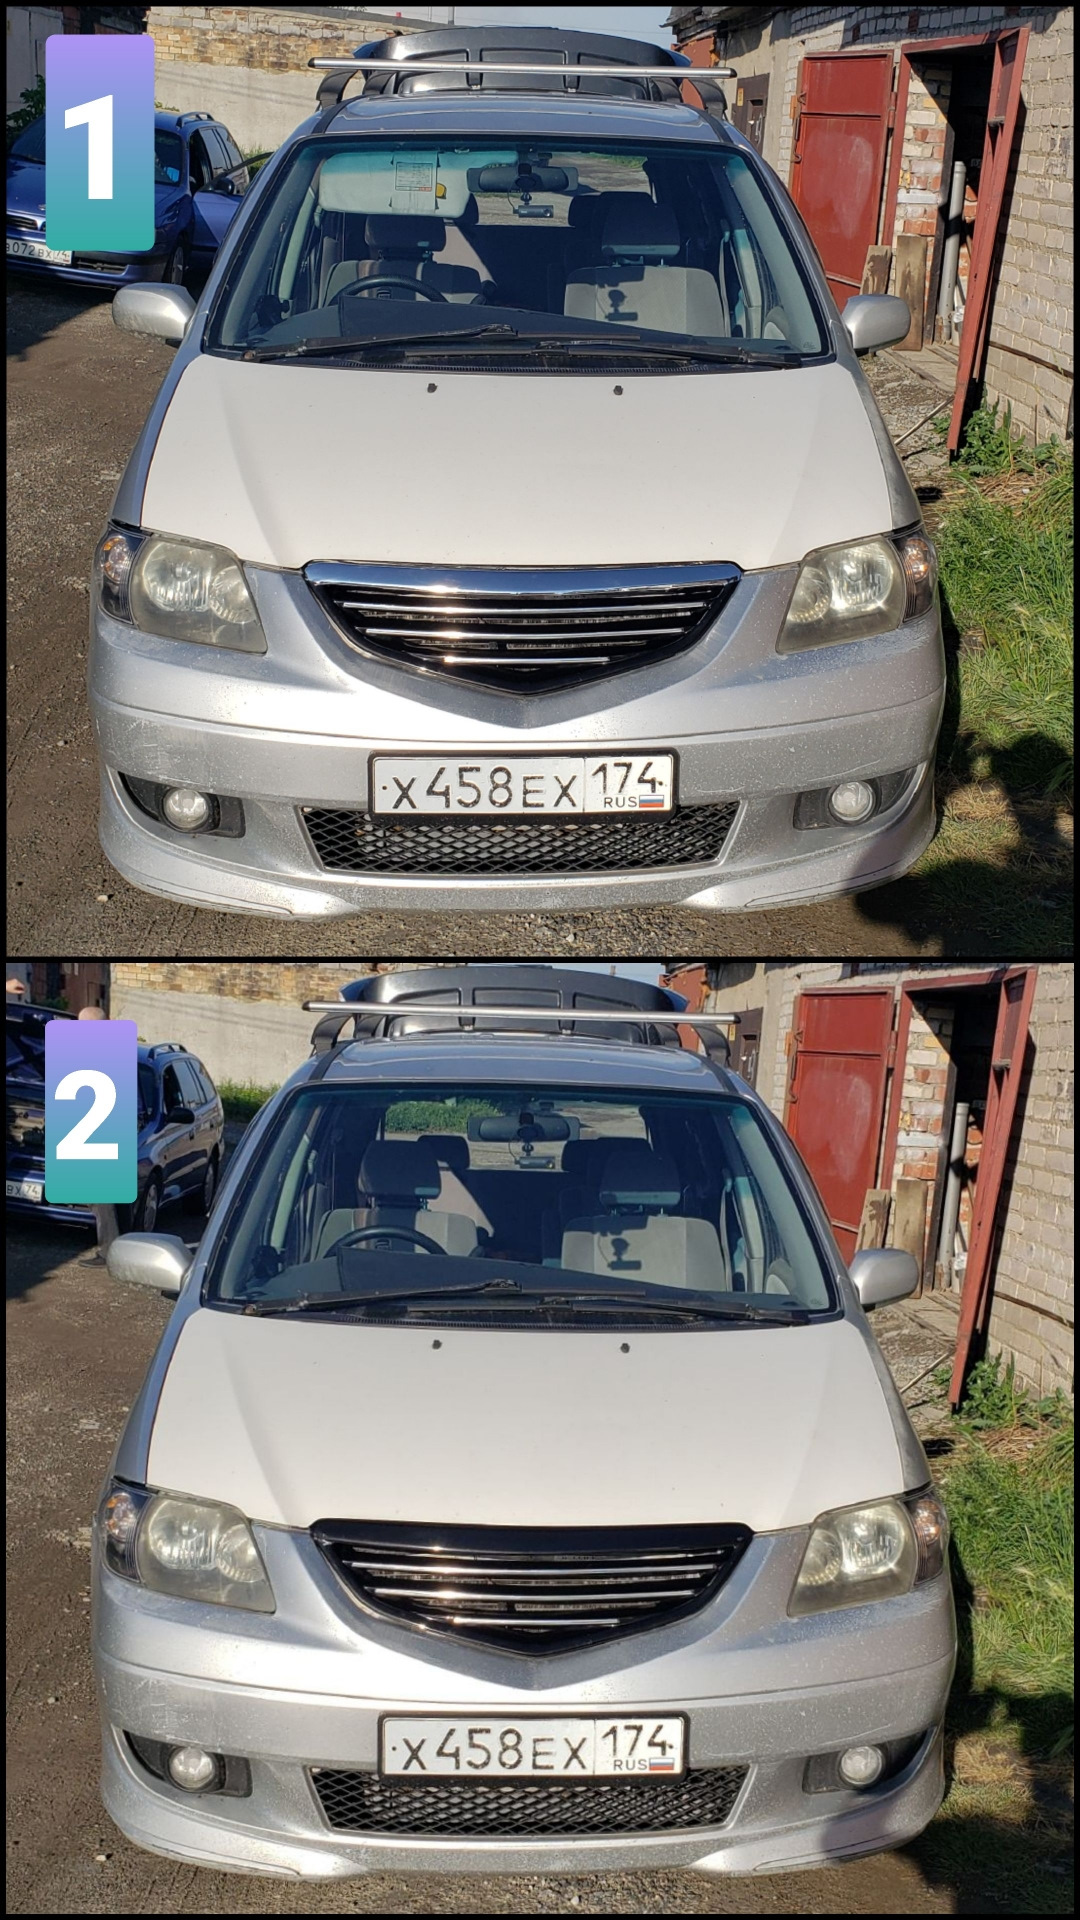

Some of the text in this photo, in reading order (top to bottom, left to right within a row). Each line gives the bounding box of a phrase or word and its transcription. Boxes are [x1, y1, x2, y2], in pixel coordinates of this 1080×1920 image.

[591, 762, 657, 794] 174
[603, 796, 638, 808] RUS
[602, 1724, 667, 1756] 174
[613, 1759, 648, 1771] RUS
